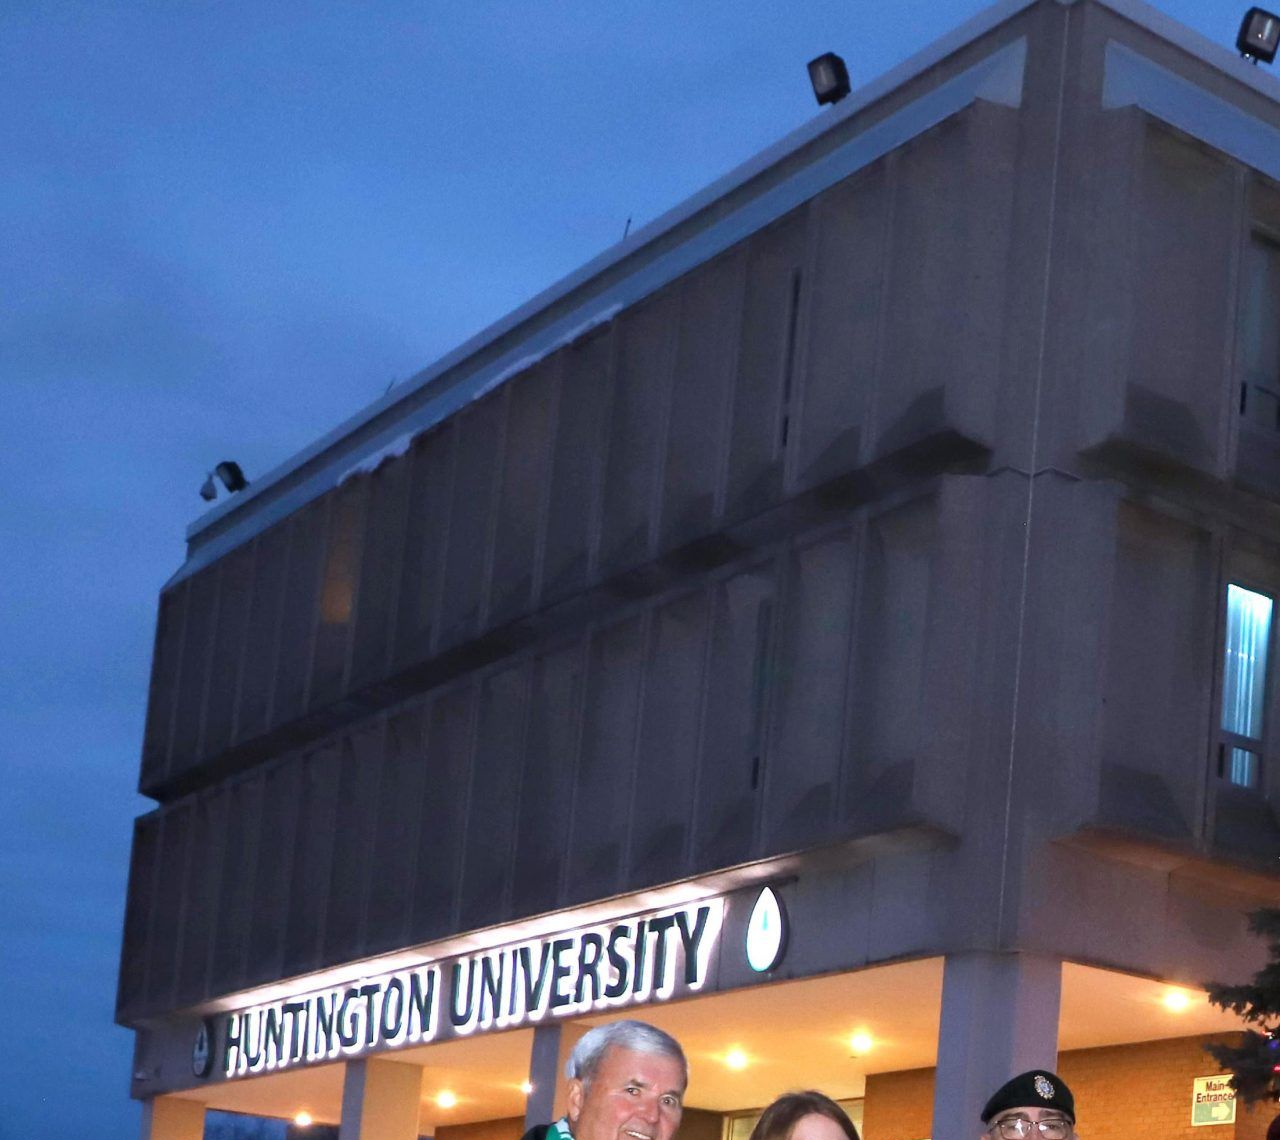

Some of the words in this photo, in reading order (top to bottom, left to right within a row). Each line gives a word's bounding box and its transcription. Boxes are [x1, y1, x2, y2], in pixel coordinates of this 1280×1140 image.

[224, 969, 436, 1073] HUNTINGTON
[450, 906, 711, 1027] UNIVERSITY
[1205, 1080, 1225, 1091] Main
[1196, 1092, 1234, 1103] Entrance
